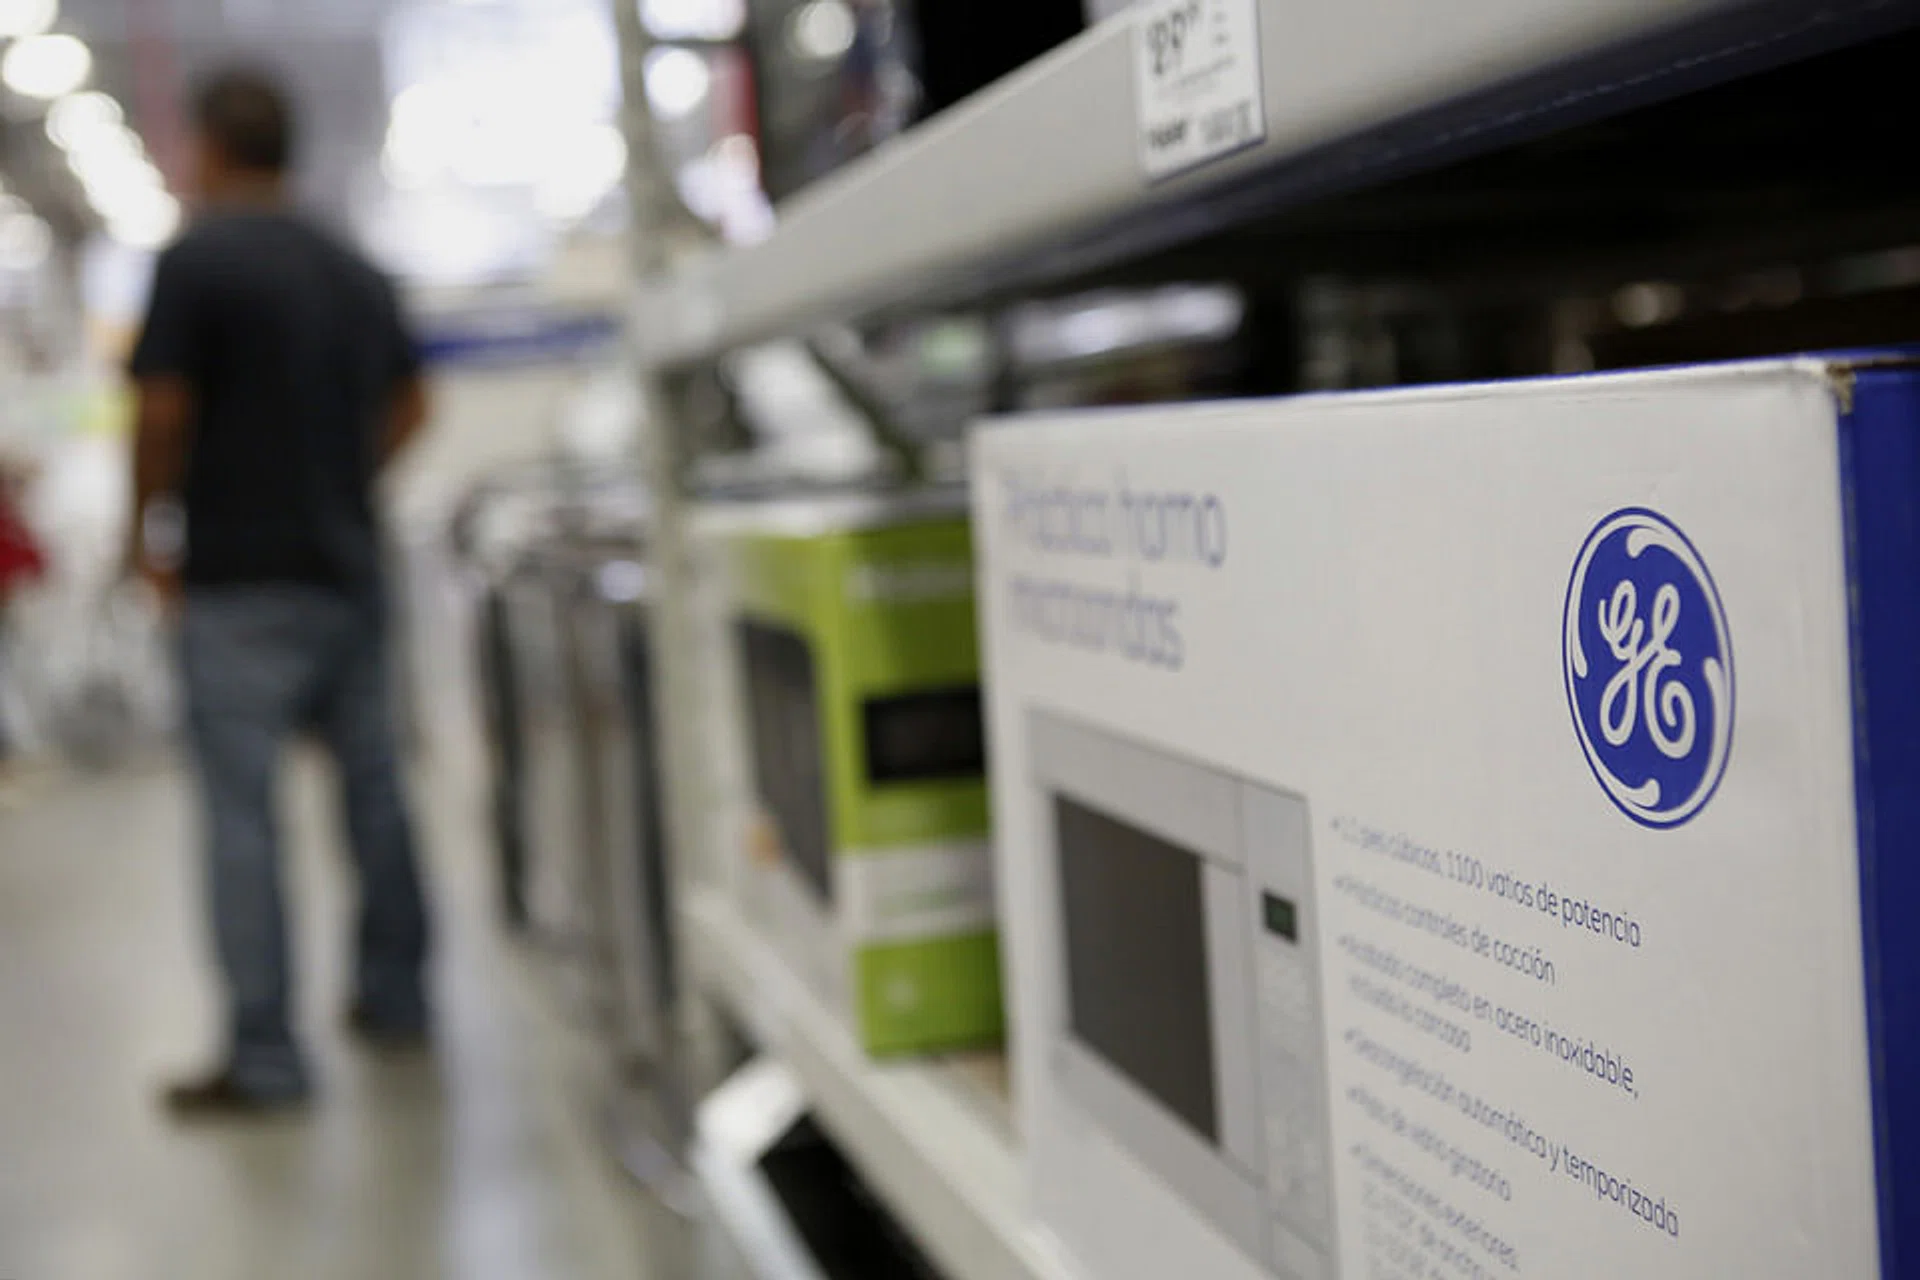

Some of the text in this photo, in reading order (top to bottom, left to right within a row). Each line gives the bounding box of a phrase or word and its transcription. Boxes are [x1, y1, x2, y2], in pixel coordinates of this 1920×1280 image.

[1598, 579, 1697, 760] GE
[1447, 849, 1484, 890] 1100
[1486, 871, 1533, 908] vatios
[1536, 881, 1558, 917] de
[1562, 896, 1641, 948] potencia
[1470, 924, 1491, 958] de
[1493, 937, 1555, 985] cocción
[1473, 994, 1494, 1024] en
[1496, 1006, 1541, 1047] acero
[1544, 1019, 1639, 1099] inoxidable,
[1459, 1090, 1547, 1160] automática
[1549, 1141, 1561, 1173] y
[1563, 1144, 1679, 1237] temporizada
